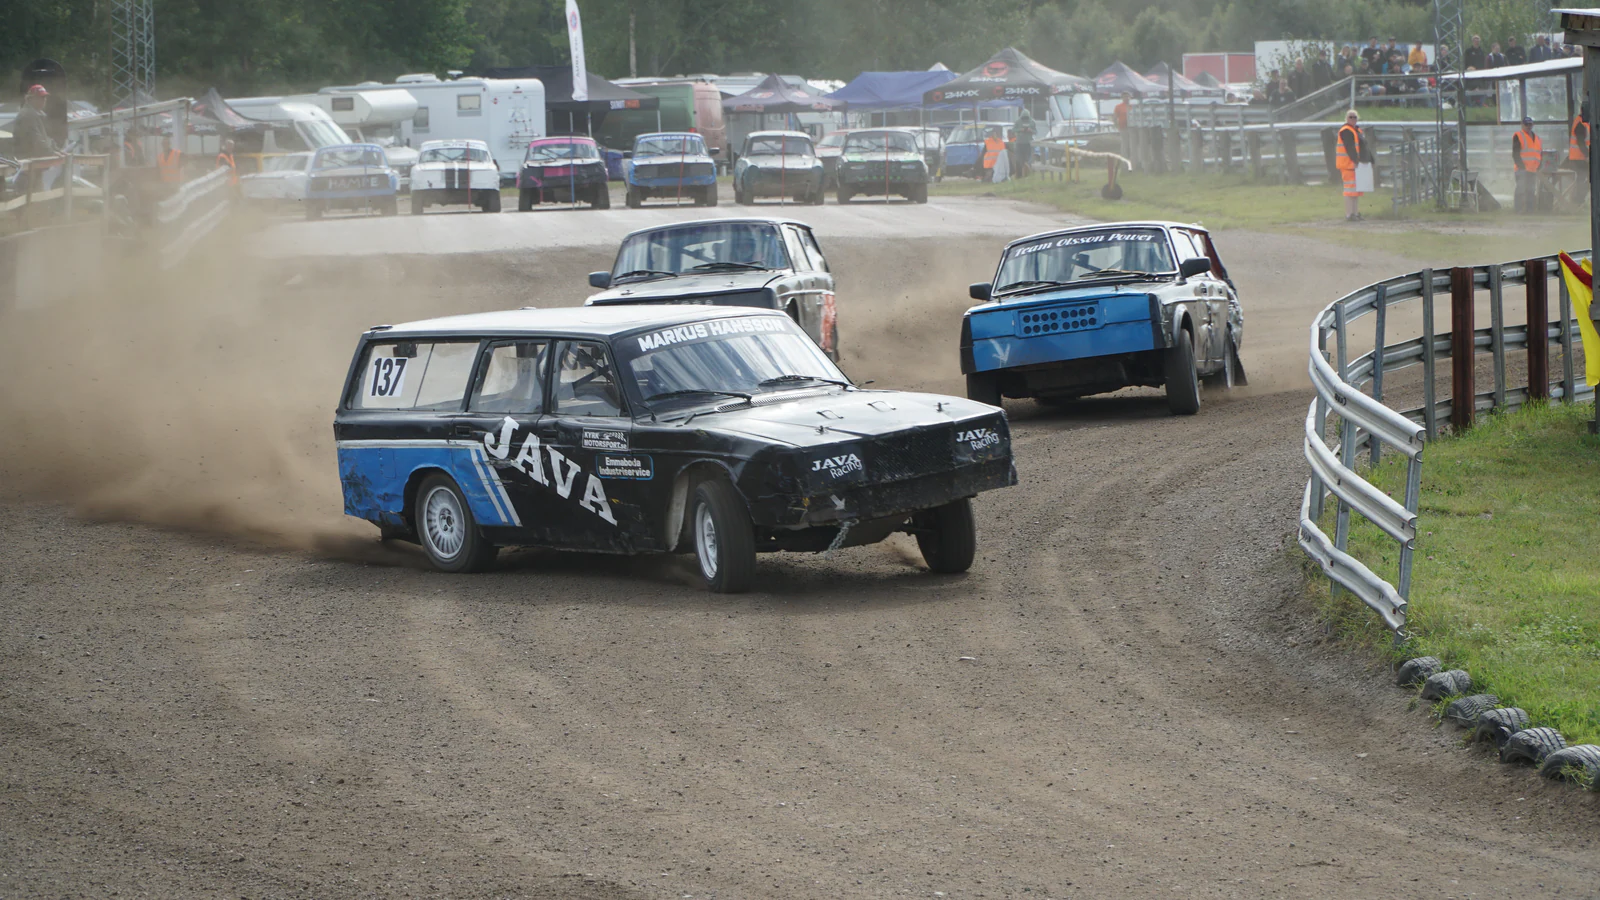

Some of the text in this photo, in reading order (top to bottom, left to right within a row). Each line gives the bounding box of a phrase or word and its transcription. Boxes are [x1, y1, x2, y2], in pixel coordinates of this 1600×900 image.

[945, 89, 980, 99] 24MX
[1005, 87, 1040, 95] 24MX
[1014, 233, 1155, 258] Team Olsson Power
[637, 318, 786, 352] MARKUS HANSSON
[371, 357, 407, 397] 137
[970, 432, 1000, 450] Racing
[599, 465, 651, 477] Industriservice
[605, 456, 642, 467] Emmaboda
[811, 453, 861, 472] JAVA
[830, 460, 862, 479] Racing
[484, 416, 618, 527] JAVA
